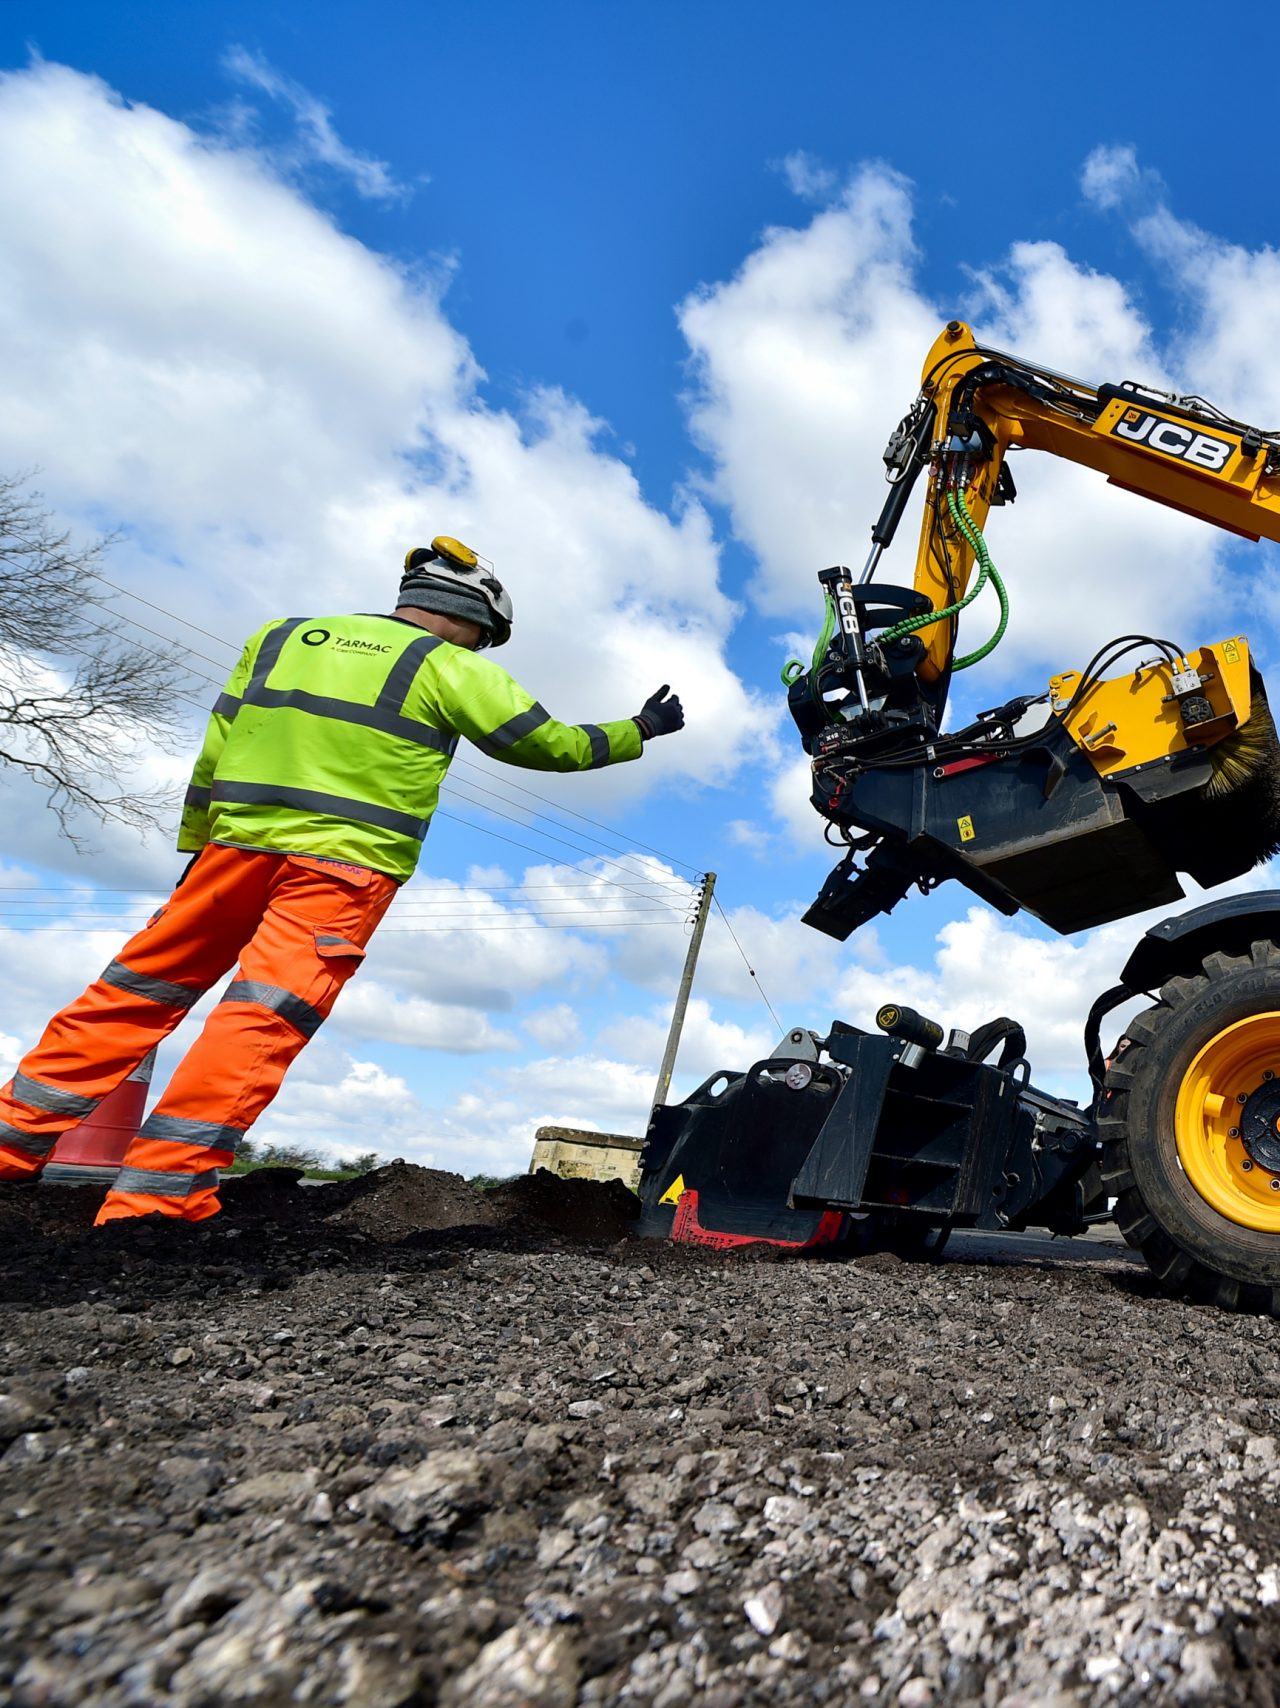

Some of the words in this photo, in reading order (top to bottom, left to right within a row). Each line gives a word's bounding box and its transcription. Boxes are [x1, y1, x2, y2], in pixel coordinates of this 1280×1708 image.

[1116, 415, 1230, 469] JCB
[835, 582, 860, 634] JCB
[335, 637, 392, 653] TARMAC
